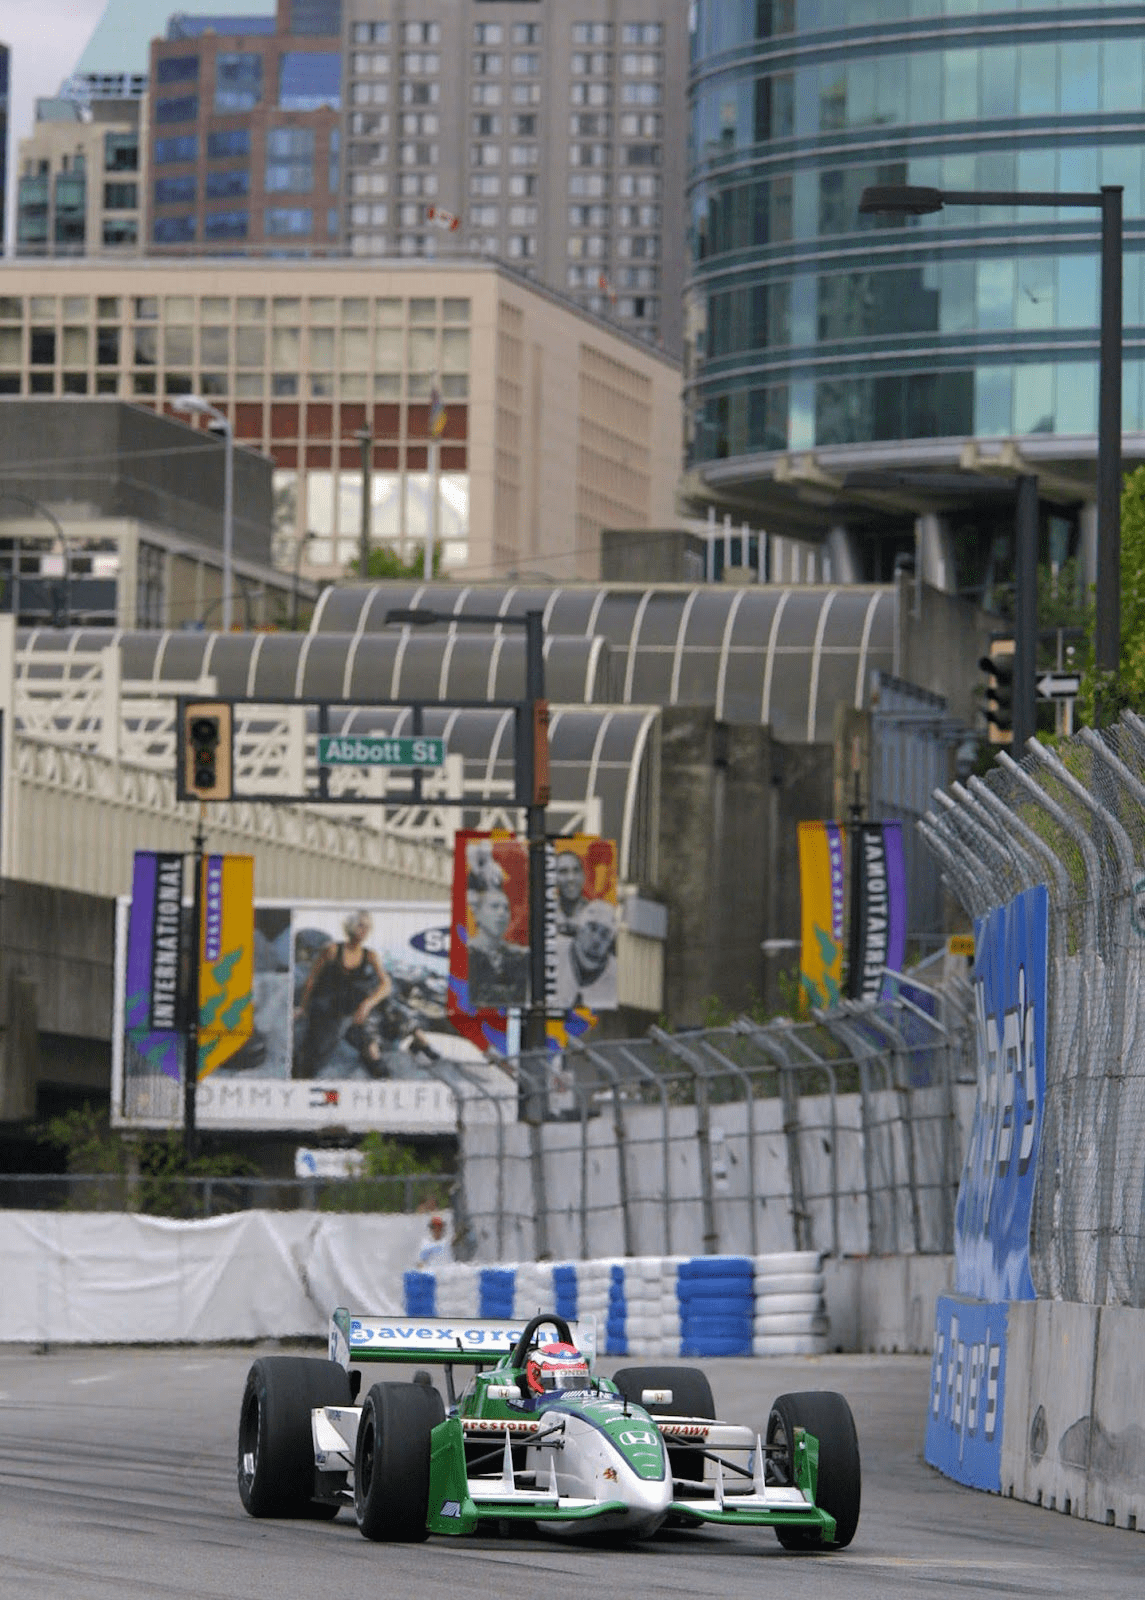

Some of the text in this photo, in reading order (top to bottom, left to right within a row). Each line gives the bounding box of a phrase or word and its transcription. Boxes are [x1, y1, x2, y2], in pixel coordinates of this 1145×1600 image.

[325, 740, 437, 762] Abbott St
[153, 859, 182, 1027] INTERNATIONAL
[195, 1084, 294, 1107] OMMY
[378, 1327, 457, 1340] avex
[462, 1421, 538, 1433] irestone
